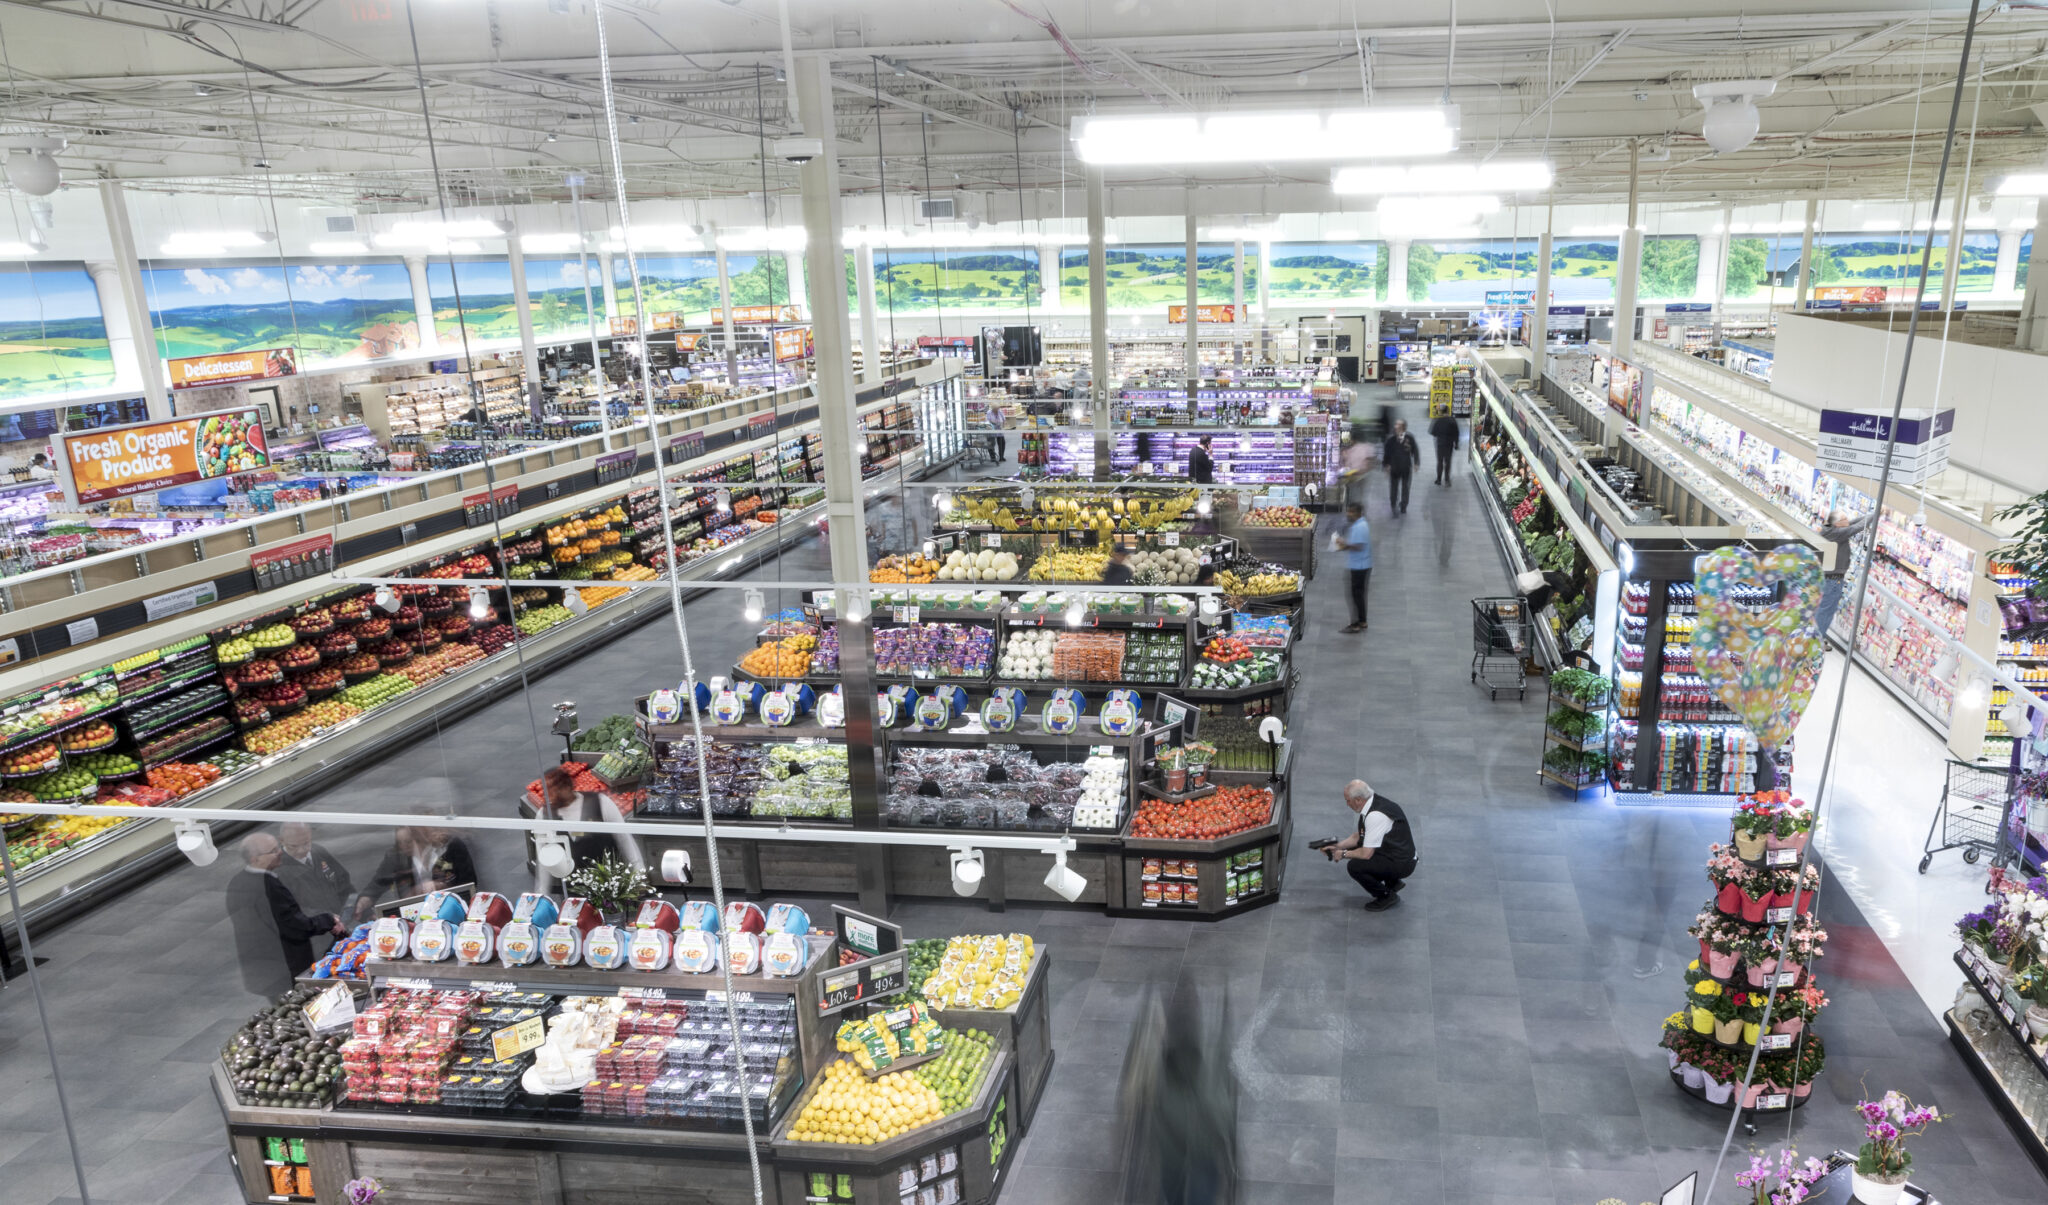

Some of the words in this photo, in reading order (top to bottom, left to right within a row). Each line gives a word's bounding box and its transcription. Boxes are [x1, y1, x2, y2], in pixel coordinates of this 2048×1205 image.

[183, 359, 253, 378] Delicatessen
[1848, 421, 1888, 436] Hallmak
[71, 436, 122, 463] Fresh
[124, 426, 190, 455] Organic
[101, 453, 173, 481] Produce
[117, 485, 137, 495] Natural
[857, 931, 875, 943] more
